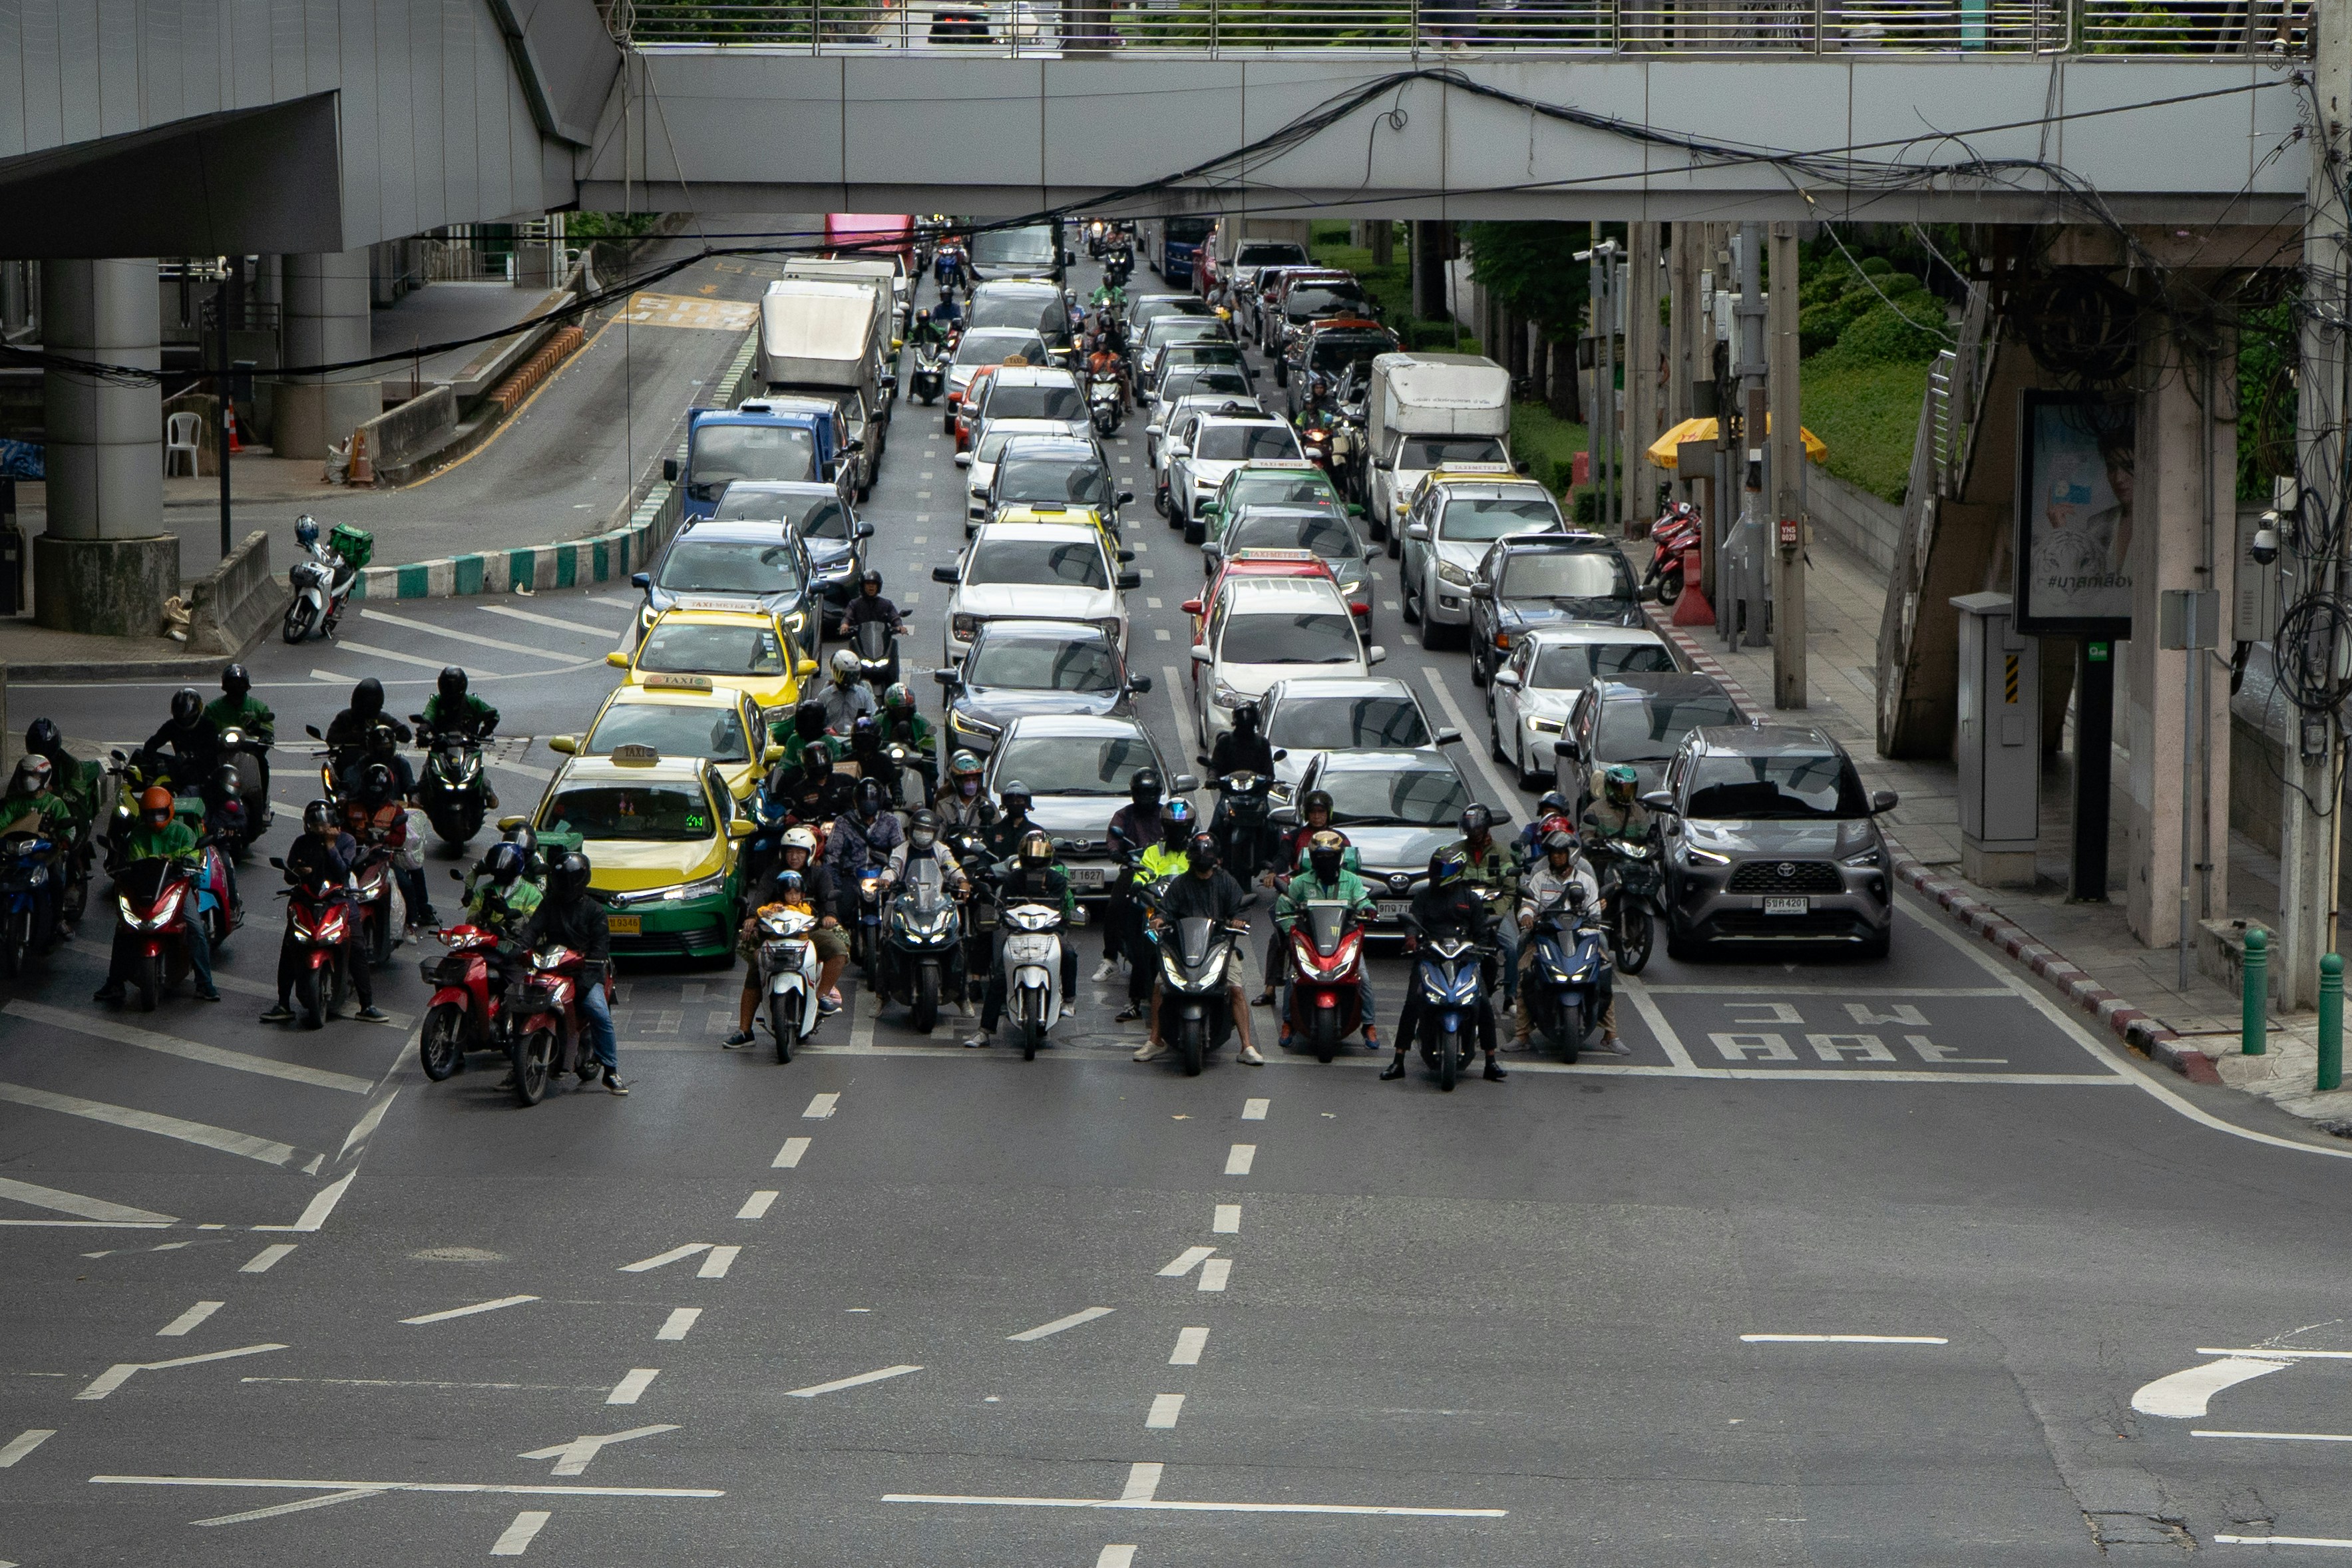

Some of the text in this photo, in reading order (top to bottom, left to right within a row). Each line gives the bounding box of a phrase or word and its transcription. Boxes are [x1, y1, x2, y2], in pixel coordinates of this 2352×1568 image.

[624, 747, 646, 757] TAXI
[1080, 871, 1101, 880] 1627
[1786, 898, 1806, 908] 4201
[617, 918, 638, 927] 9346
